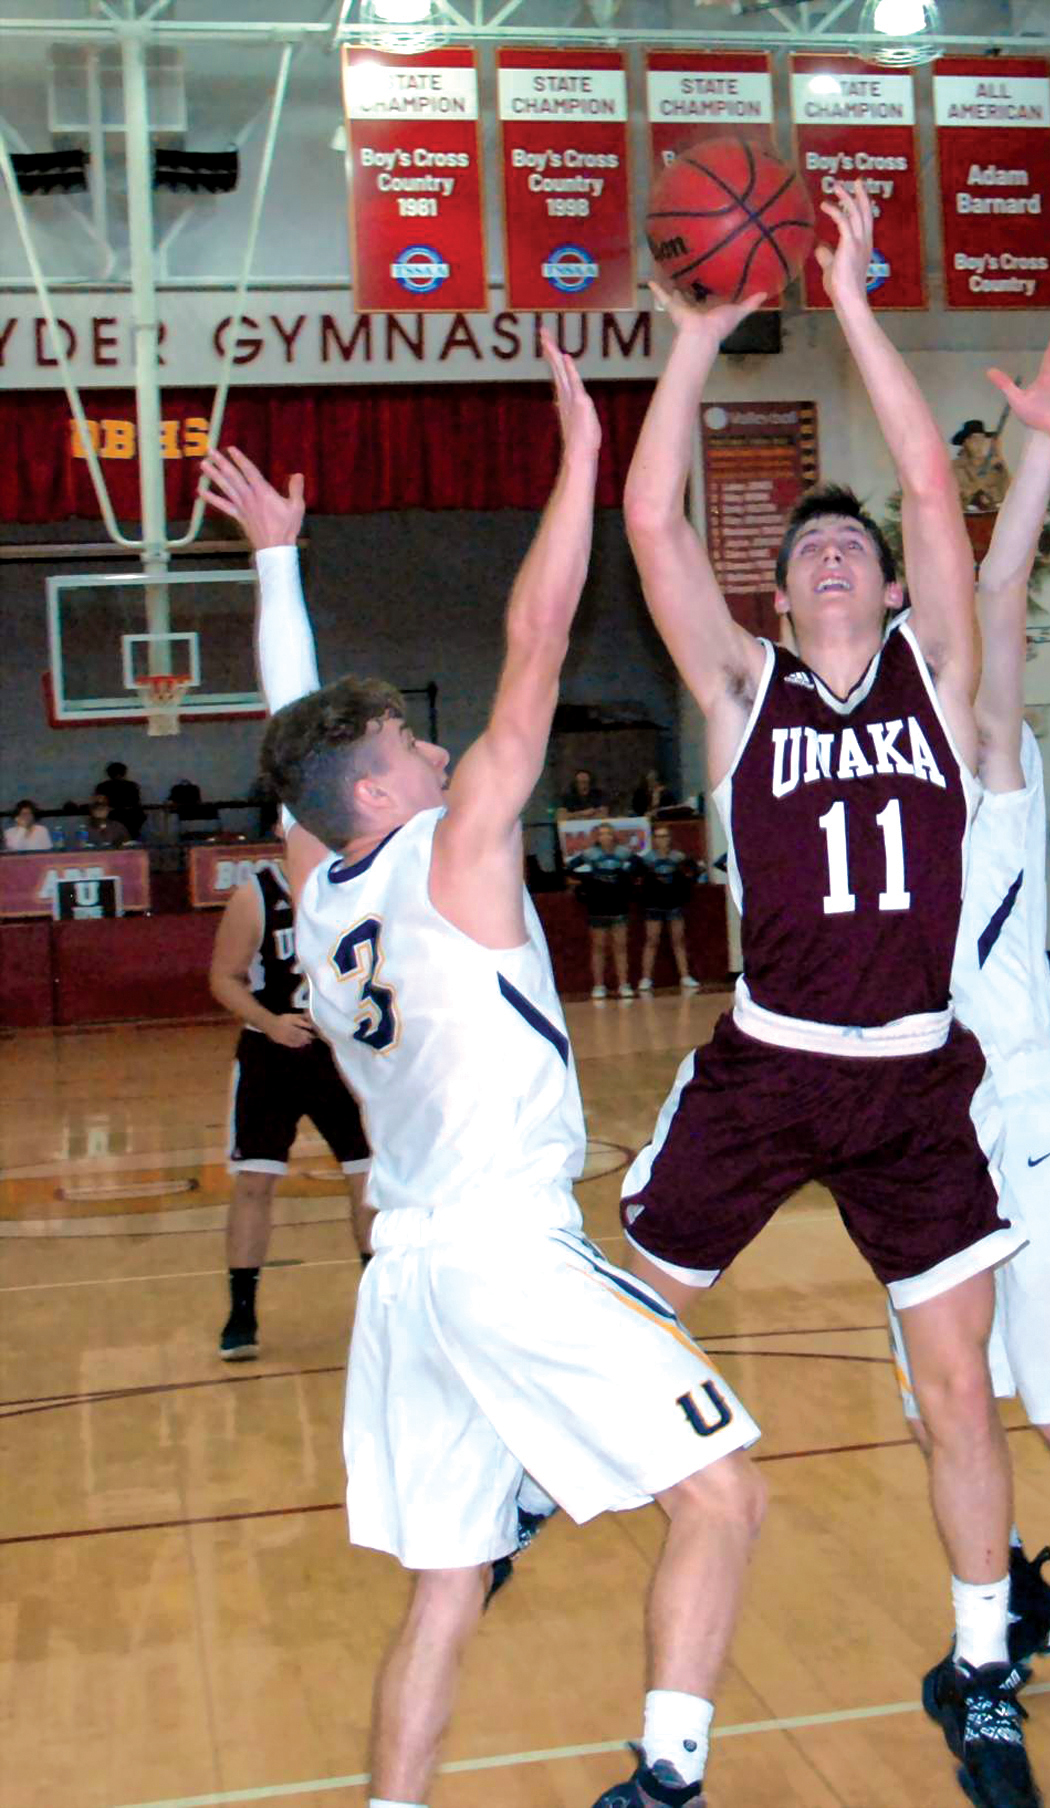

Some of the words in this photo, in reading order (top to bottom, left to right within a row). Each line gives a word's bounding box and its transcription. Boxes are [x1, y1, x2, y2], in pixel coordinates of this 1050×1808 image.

[533, 76, 592, 92] STATE
[680, 78, 738, 95] STATE
[828, 80, 881, 97] TATE
[976, 83, 1012, 99] ALL
[512, 98, 615, 115] CHAMPION
[660, 100, 761, 117] CHAMPION
[804, 102, 903, 119] CHAMPION
[949, 103, 1043, 120] AMERICAN
[360, 147, 411, 169] Boy's
[413, 149, 469, 167] Cross
[511, 148, 562, 171] Boy's
[563, 150, 619, 168] Cross
[806, 152, 853, 173] Boy's
[854, 153, 907, 170] Cross
[377, 174, 454, 195] Country
[528, 174, 604, 196] Country
[967, 164, 1029, 186] Adam
[956, 193, 1042, 214] Barnard
[954, 253, 999, 273] Boy's
[1000, 253, 1049, 270] Cross
[969, 275, 1036, 296] Country
[213, 311, 653, 366] GYMNASIUM
[771, 716, 947, 799] UNAKA
[818, 799, 911, 915] 11
[327, 912, 401, 1058] 3
[675, 1379, 734, 1437] U
